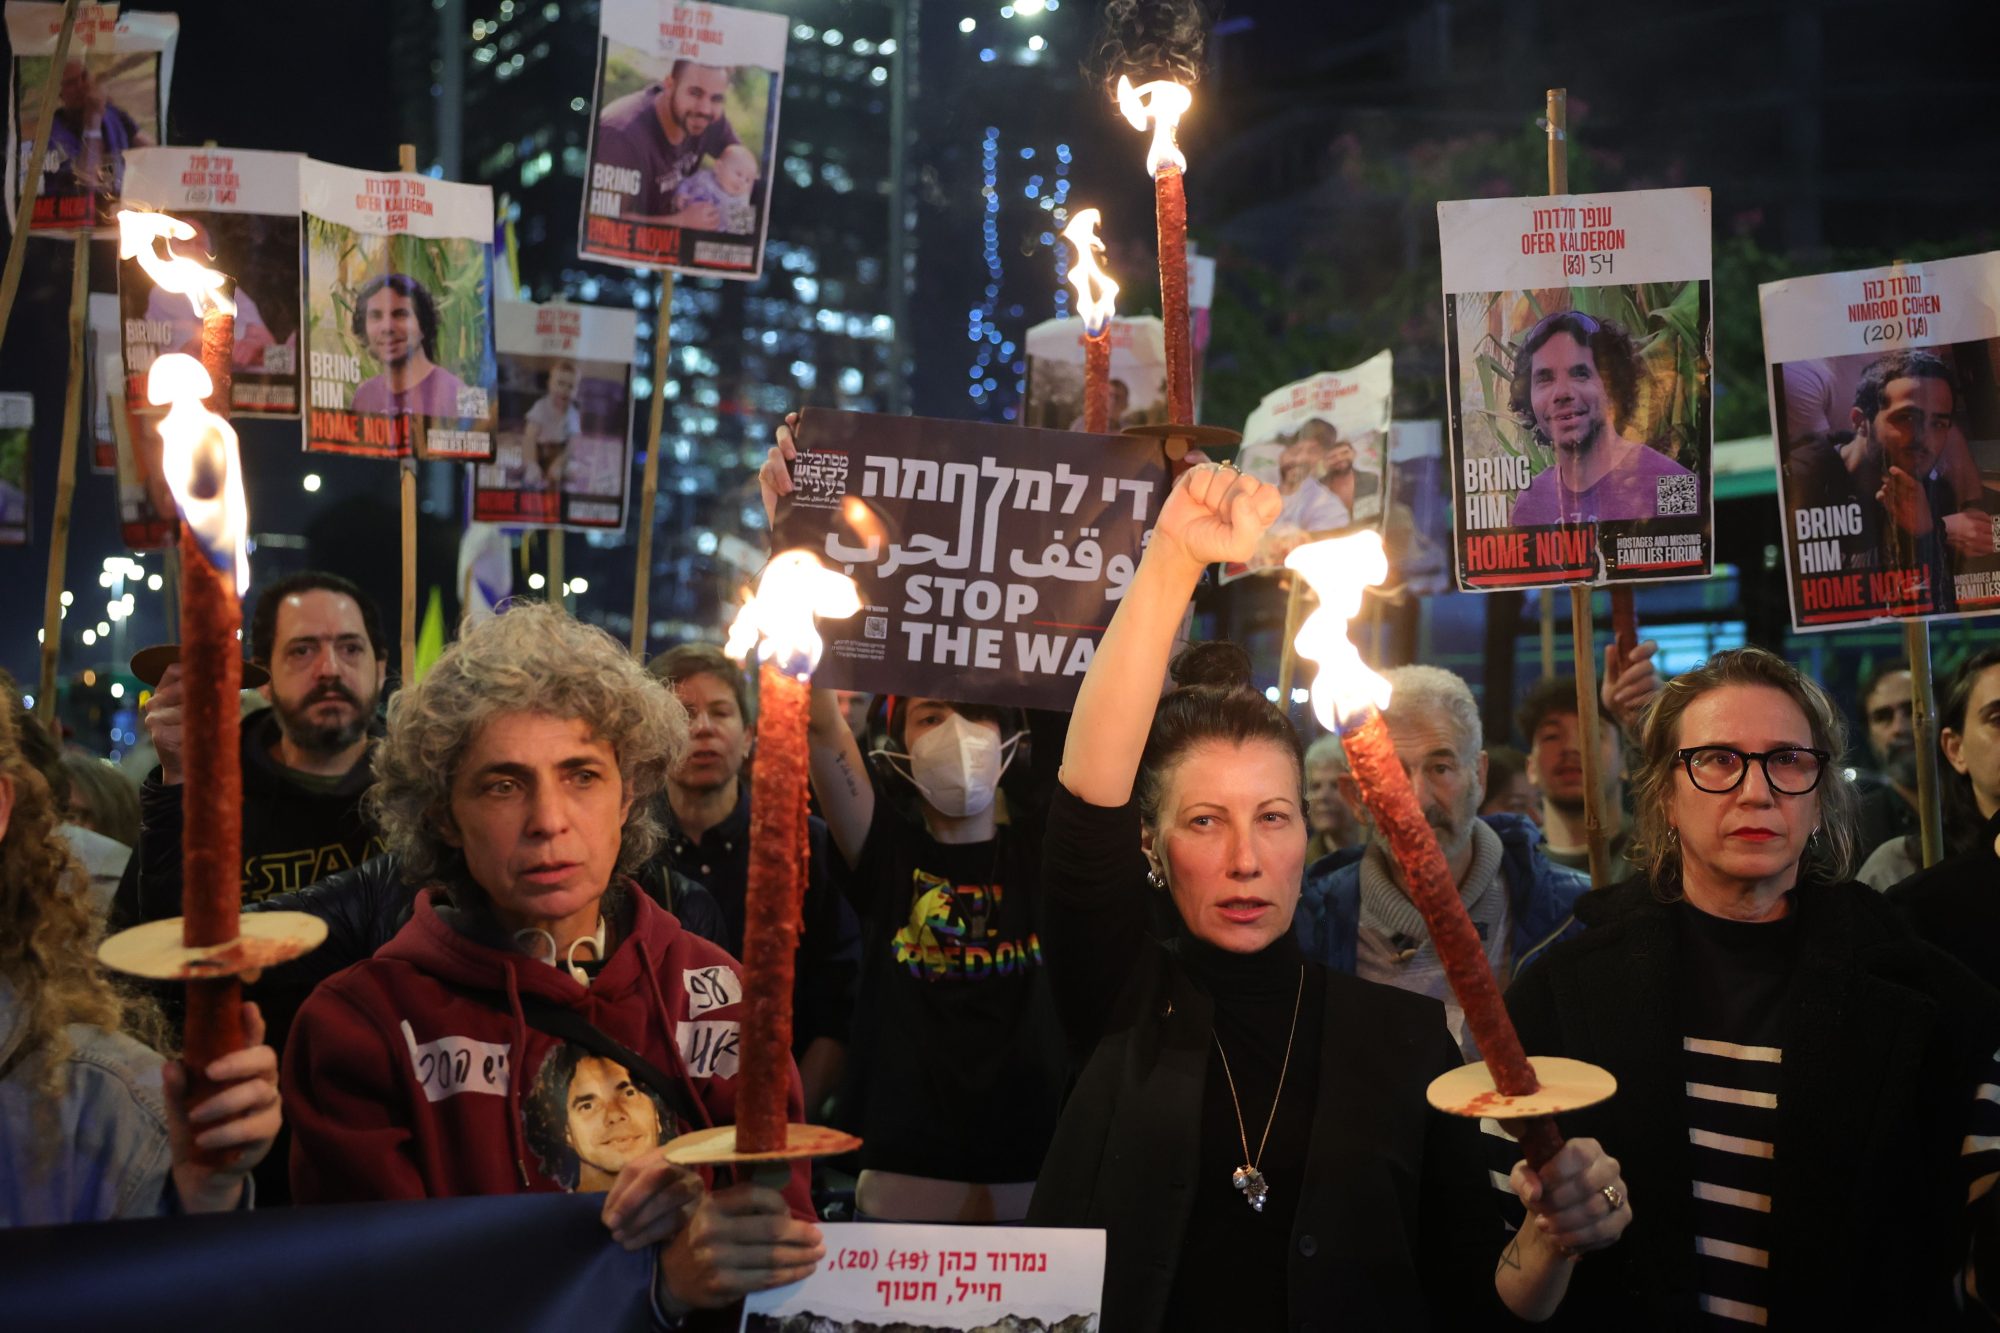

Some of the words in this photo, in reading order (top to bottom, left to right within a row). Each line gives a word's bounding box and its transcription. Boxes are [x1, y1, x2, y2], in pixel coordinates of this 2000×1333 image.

[592, 163, 641, 195] BRING
[590, 190, 621, 218] HIM
[1579, 206, 1612, 229] עופר
[1533, 207, 1576, 232] קלדרון
[1521, 232, 1556, 255] OFER
[1559, 229, 1625, 252] KALDERON
[1589, 253, 1613, 274] 54
[1863, 280, 1885, 302] כהן
[1888, 275, 1922, 296] נמרוד
[1848, 299, 1898, 322] NIMROD
[1902, 295, 1941, 315] COHEN
[126, 319, 172, 345] BRING
[1863, 321, 1902, 345] (20)
[310, 352, 361, 383] BRING
[311, 380, 344, 409] HIM
[312, 412, 359, 443] HOME
[364, 416, 411, 447] NOW!
[796, 449, 848, 467] מסתכלים
[861, 455, 1089, 514] למלחמה
[1464, 455, 1531, 493] BRING
[1100, 477, 1154, 521] די
[1466, 494, 1508, 530] HIM
[1795, 503, 1863, 540] BRING
[1467, 533, 1530, 571] HOME
[1535, 524, 1596, 568] NOW!
[1617, 536, 1654, 549] HOSTAGES
[1655, 536, 1669, 547] AND
[1670, 534, 1701, 546] MISSING
[1617, 547, 1665, 566] FAMILIES
[1665, 545, 1702, 563] FORUM
[1009, 527, 1153, 601] وقف
[1798, 540, 1842, 574] HIM
[904, 574, 1038, 623] STOP
[1801, 574, 1865, 610] HOME
[1869, 564, 1931, 604] NOW!
[901, 621, 1003, 668] THE
[1015, 632, 1098, 675] WA
[240, 836, 388, 898] STA
[690, 968, 729, 1008] 98
[419, 1048, 471, 1089] הסכ
[938, 1250, 976, 1276] כהן
[987, 1252, 1047, 1272] נמרוד
[877, 1280, 937, 1307] חטוף
[946, 1277, 1001, 1306] חייל,
